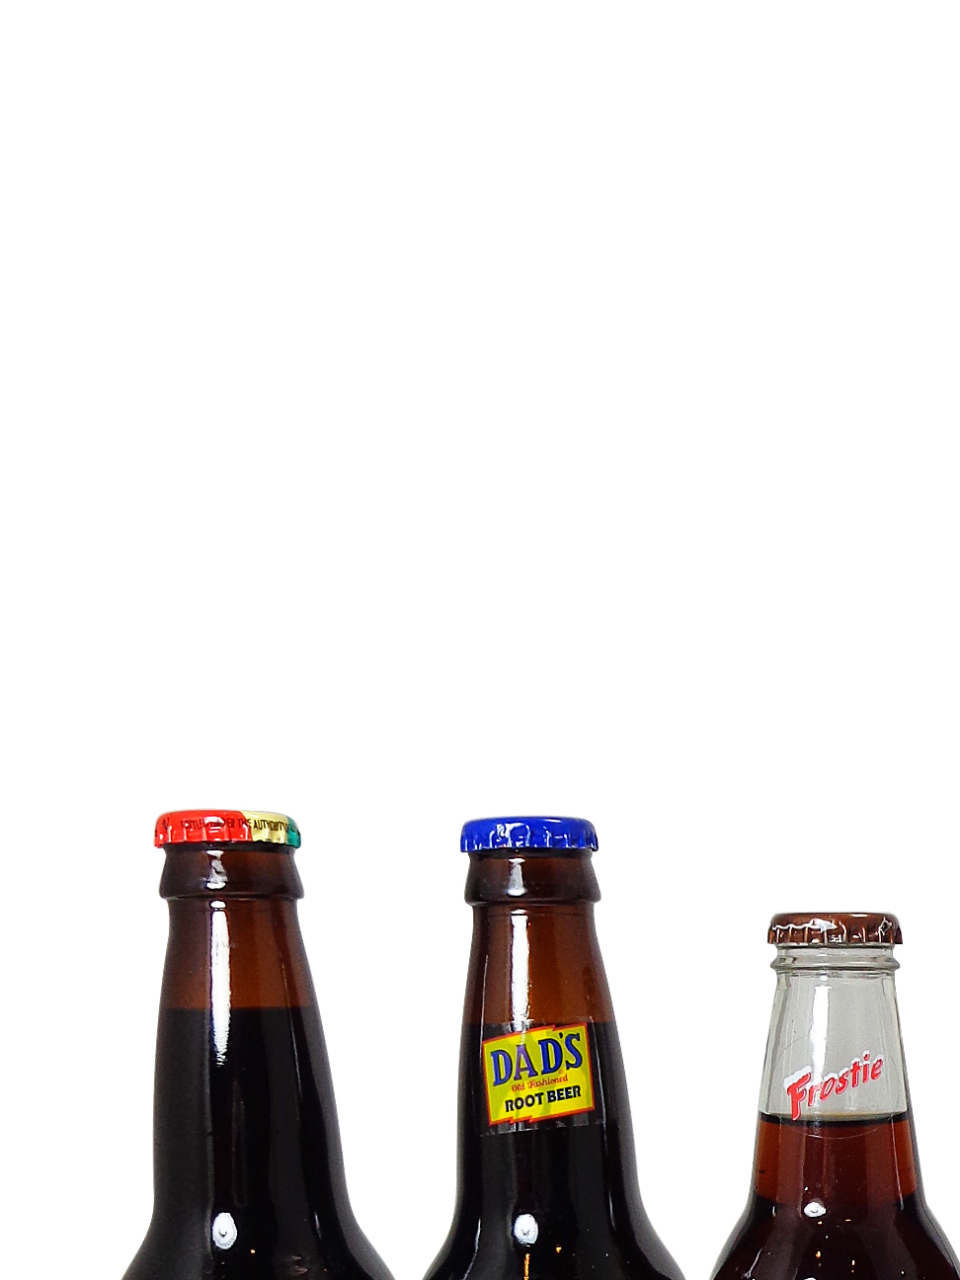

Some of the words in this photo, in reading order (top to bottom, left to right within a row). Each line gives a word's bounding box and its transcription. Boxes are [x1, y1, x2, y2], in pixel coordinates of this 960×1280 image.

[490, 1032, 583, 1087] DAD'S
[505, 1092, 545, 1112] ROOT
[546, 1085, 581, 1103] BEER
[512, 1082, 525, 1092] Old
[527, 1074, 568, 1089] Fashioned
[784, 1050, 884, 1121] Frostie
